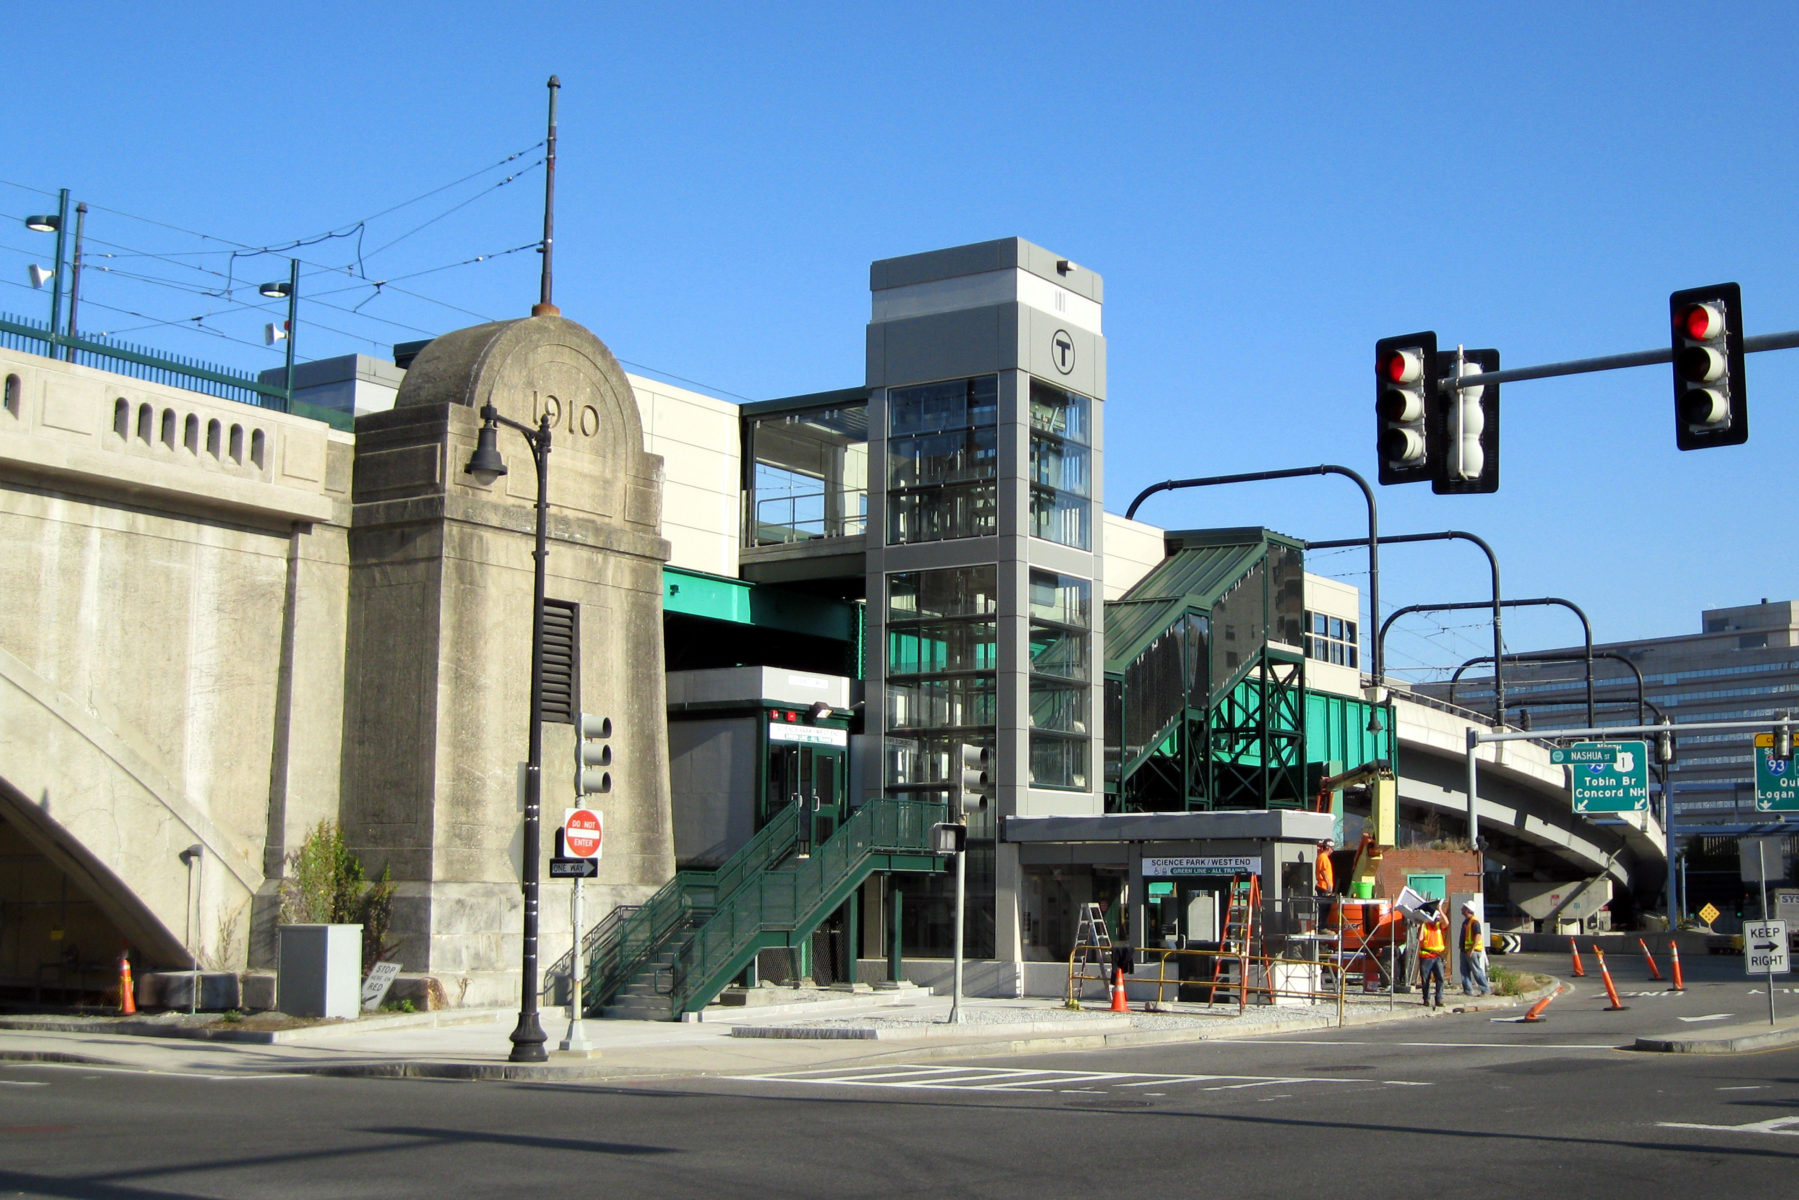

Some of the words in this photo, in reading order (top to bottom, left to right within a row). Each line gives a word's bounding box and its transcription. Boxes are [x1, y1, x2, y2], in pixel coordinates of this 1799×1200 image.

[1056, 339, 1071, 367] T
[532, 390, 600, 438] 1910
[1571, 752, 1603, 760] NASHUA
[1768, 760, 1785, 772] 93
[1584, 777, 1616, 786] Tobin
[1622, 776, 1636, 786] Br
[1576, 788, 1624, 798] Concord
[1630, 788, 1645, 796] NH
[1758, 789, 1795, 800] Logan
[572, 820, 581, 828] DO
[574, 838, 594, 847] ENTER
[553, 864, 567, 872] ONE
[570, 864, 584, 872] WAY
[1750, 927, 1780, 938] KEEP
[1751, 955, 1783, 966] RIGHT
[376, 965, 397, 973] STOP
[368, 982, 384, 991] RED
